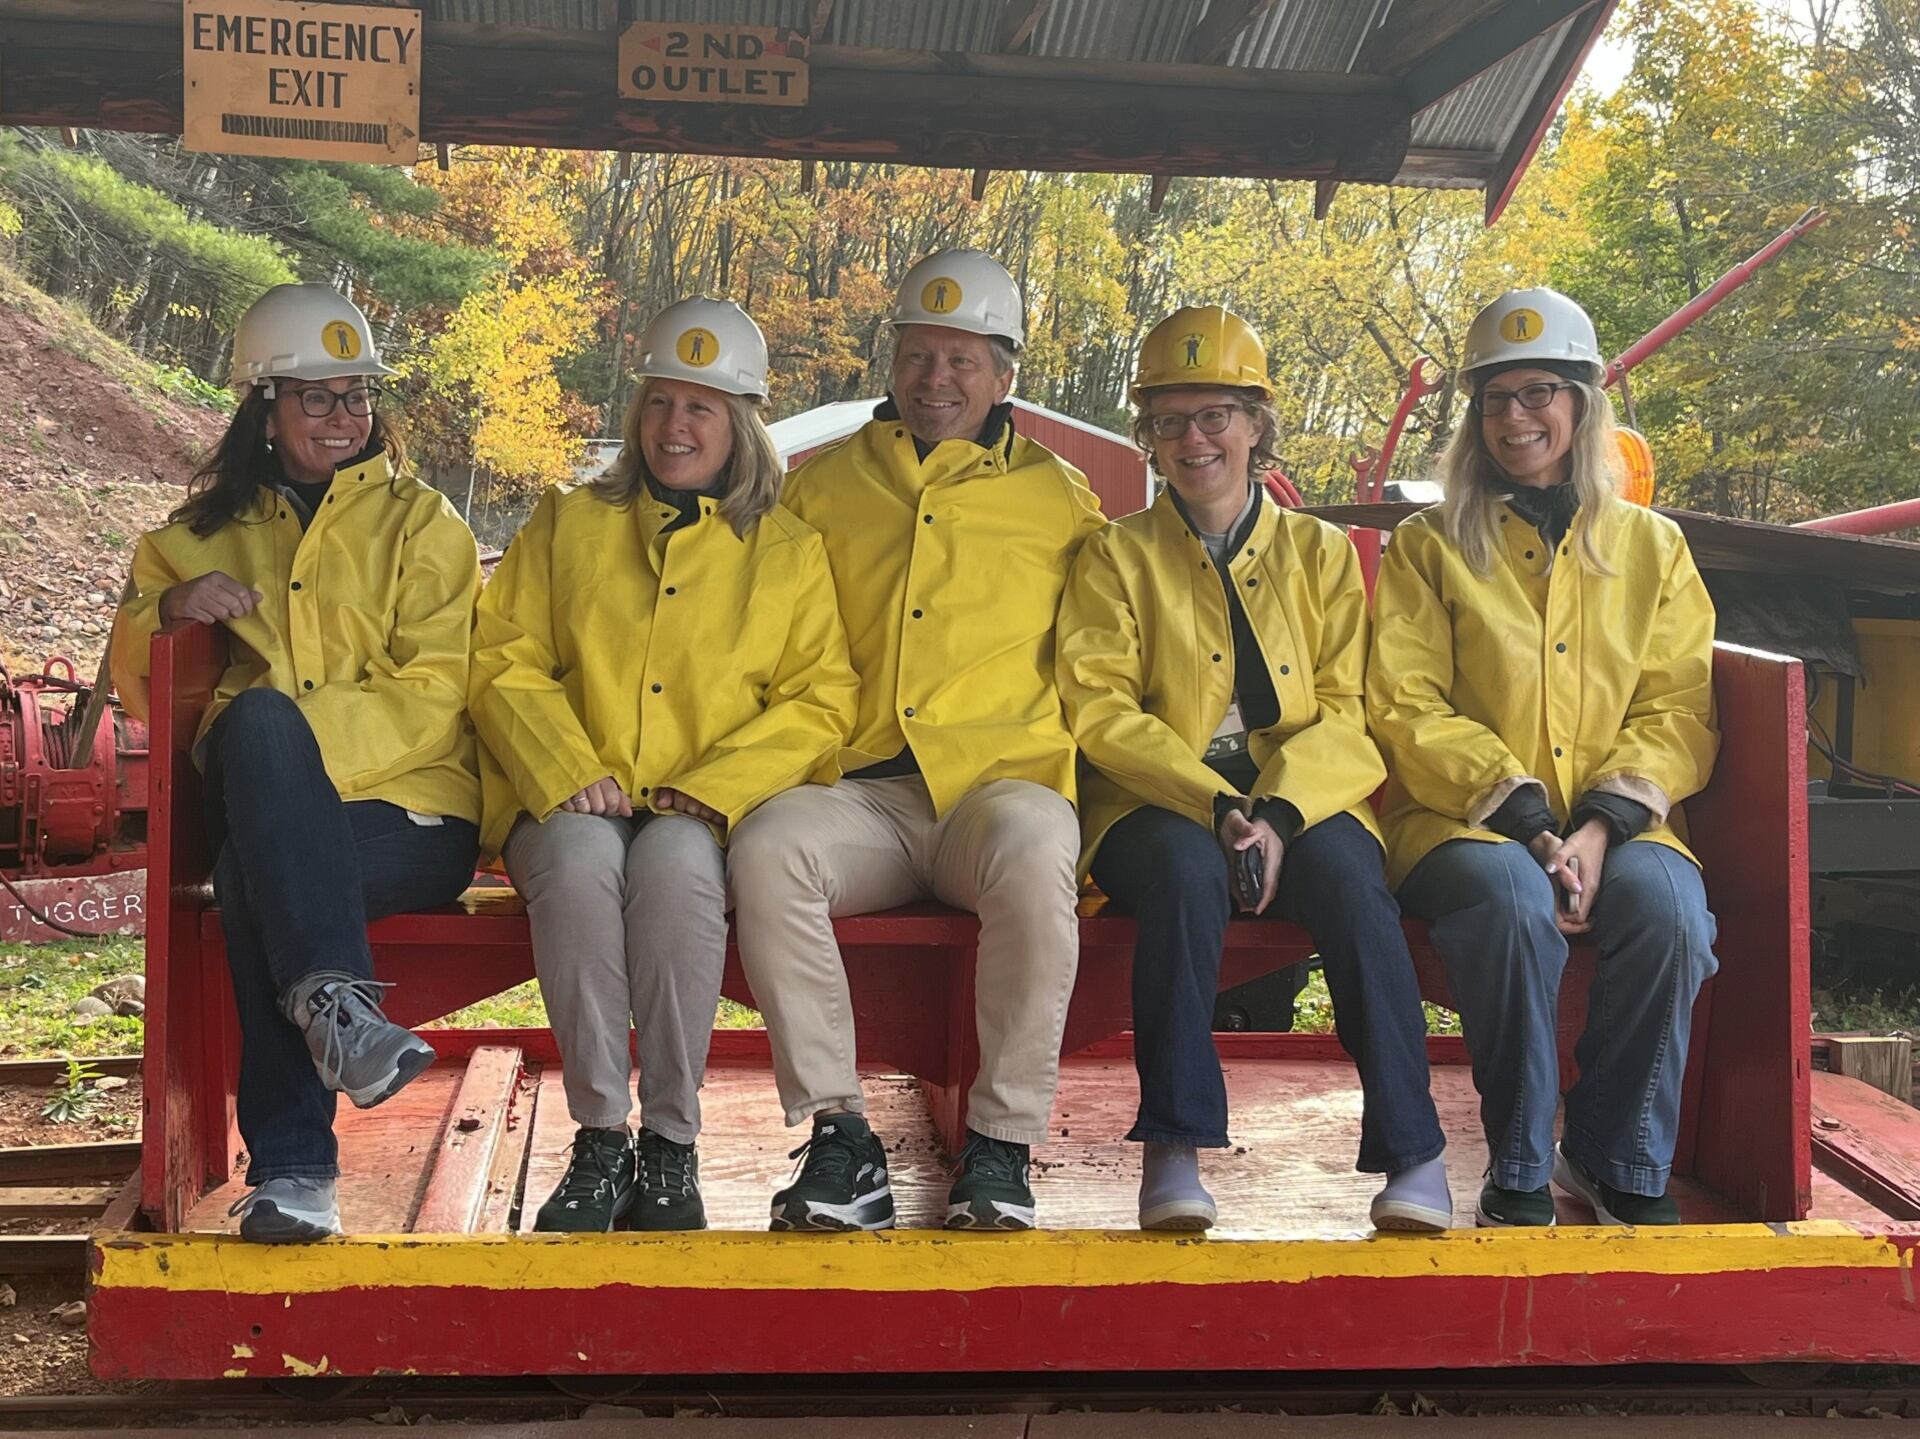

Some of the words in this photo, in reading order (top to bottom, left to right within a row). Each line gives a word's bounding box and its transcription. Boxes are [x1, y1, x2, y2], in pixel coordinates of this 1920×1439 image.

[193, 13, 415, 65] EMERGENCY
[269, 68, 348, 108] EXIT
[631, 65, 796, 96] OUTLET
[9, 894, 143, 924] TUGGER
